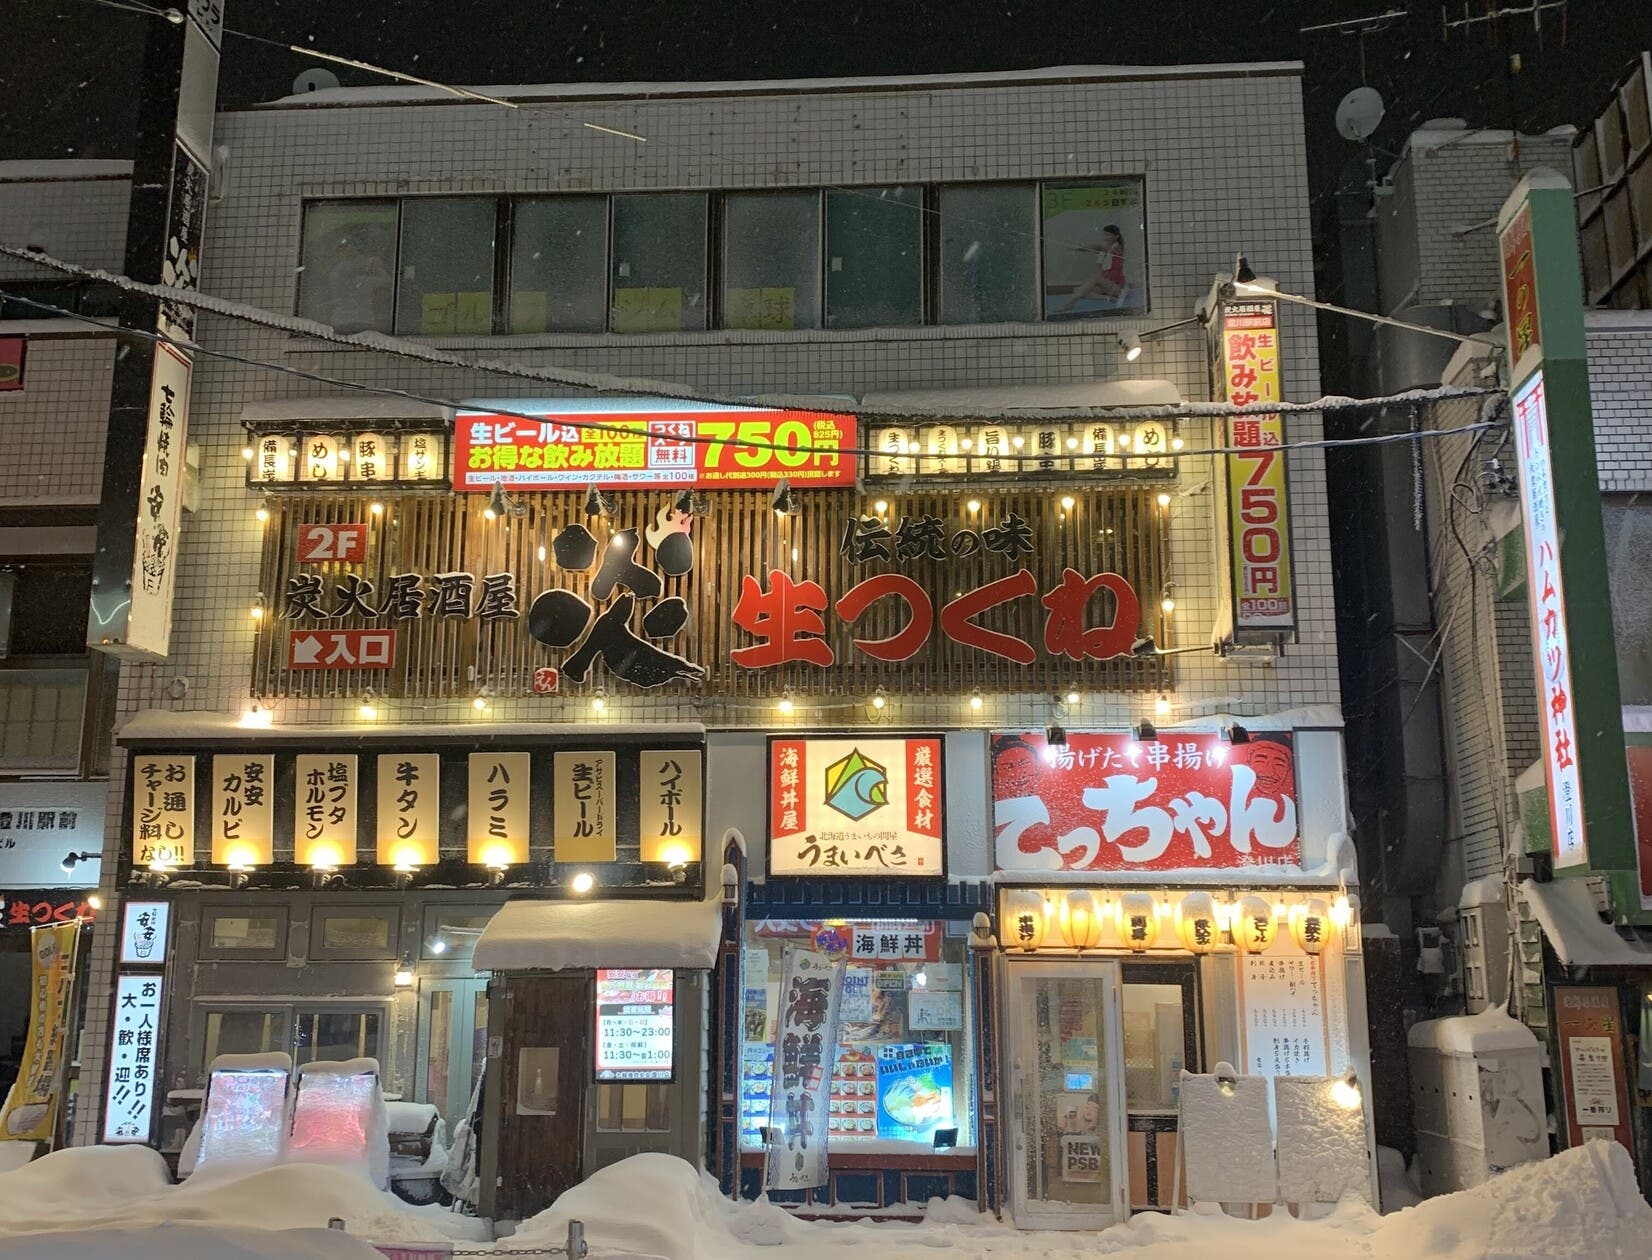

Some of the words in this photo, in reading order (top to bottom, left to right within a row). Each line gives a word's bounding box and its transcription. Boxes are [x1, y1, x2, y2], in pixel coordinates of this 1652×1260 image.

[470, 421, 579, 445] 生ビール込
[654, 423, 690, 437] つくね
[656, 448, 688, 463] 無料
[698, 421, 812, 468] 750
[813, 440, 840, 467] 円
[312, 442, 328, 479] めし
[359, 440, 376, 479] 豚串
[468, 443, 645, 470] お得な飲み放題
[305, 527, 359, 559] 2F
[838, 512, 1035, 564] 伝統の味
[1238, 452, 1281, 595] 750円
[280, 571, 521, 620] 炭火居酒屋
[730, 568, 1138, 668] 生つくね
[325, 634, 391, 665] 入口
[139, 763, 163, 841] チャージ料
[163, 763, 187, 840] お通し
[222, 773, 243, 840] カルビ
[243, 762, 265, 806] 安安
[306, 768, 326, 840] ホルモン
[327, 762, 349, 825] 塩ブタ
[396, 762, 419, 840] 牛タン
[487, 762, 511, 839] ハラミ
[571, 763, 594, 838] 生ビール
[659, 759, 683, 837] ハイボール
[779, 747, 800, 831] 海鮮丼屋
[913, 746, 935, 831] 厳選食材
[819, 831, 898, 841] 北海道うまいもの問屋
[994, 764, 1297, 871] てっちゃん
[797, 834, 907, 868] うまいべさ
[855, 934, 924, 954] 海鮮丼
